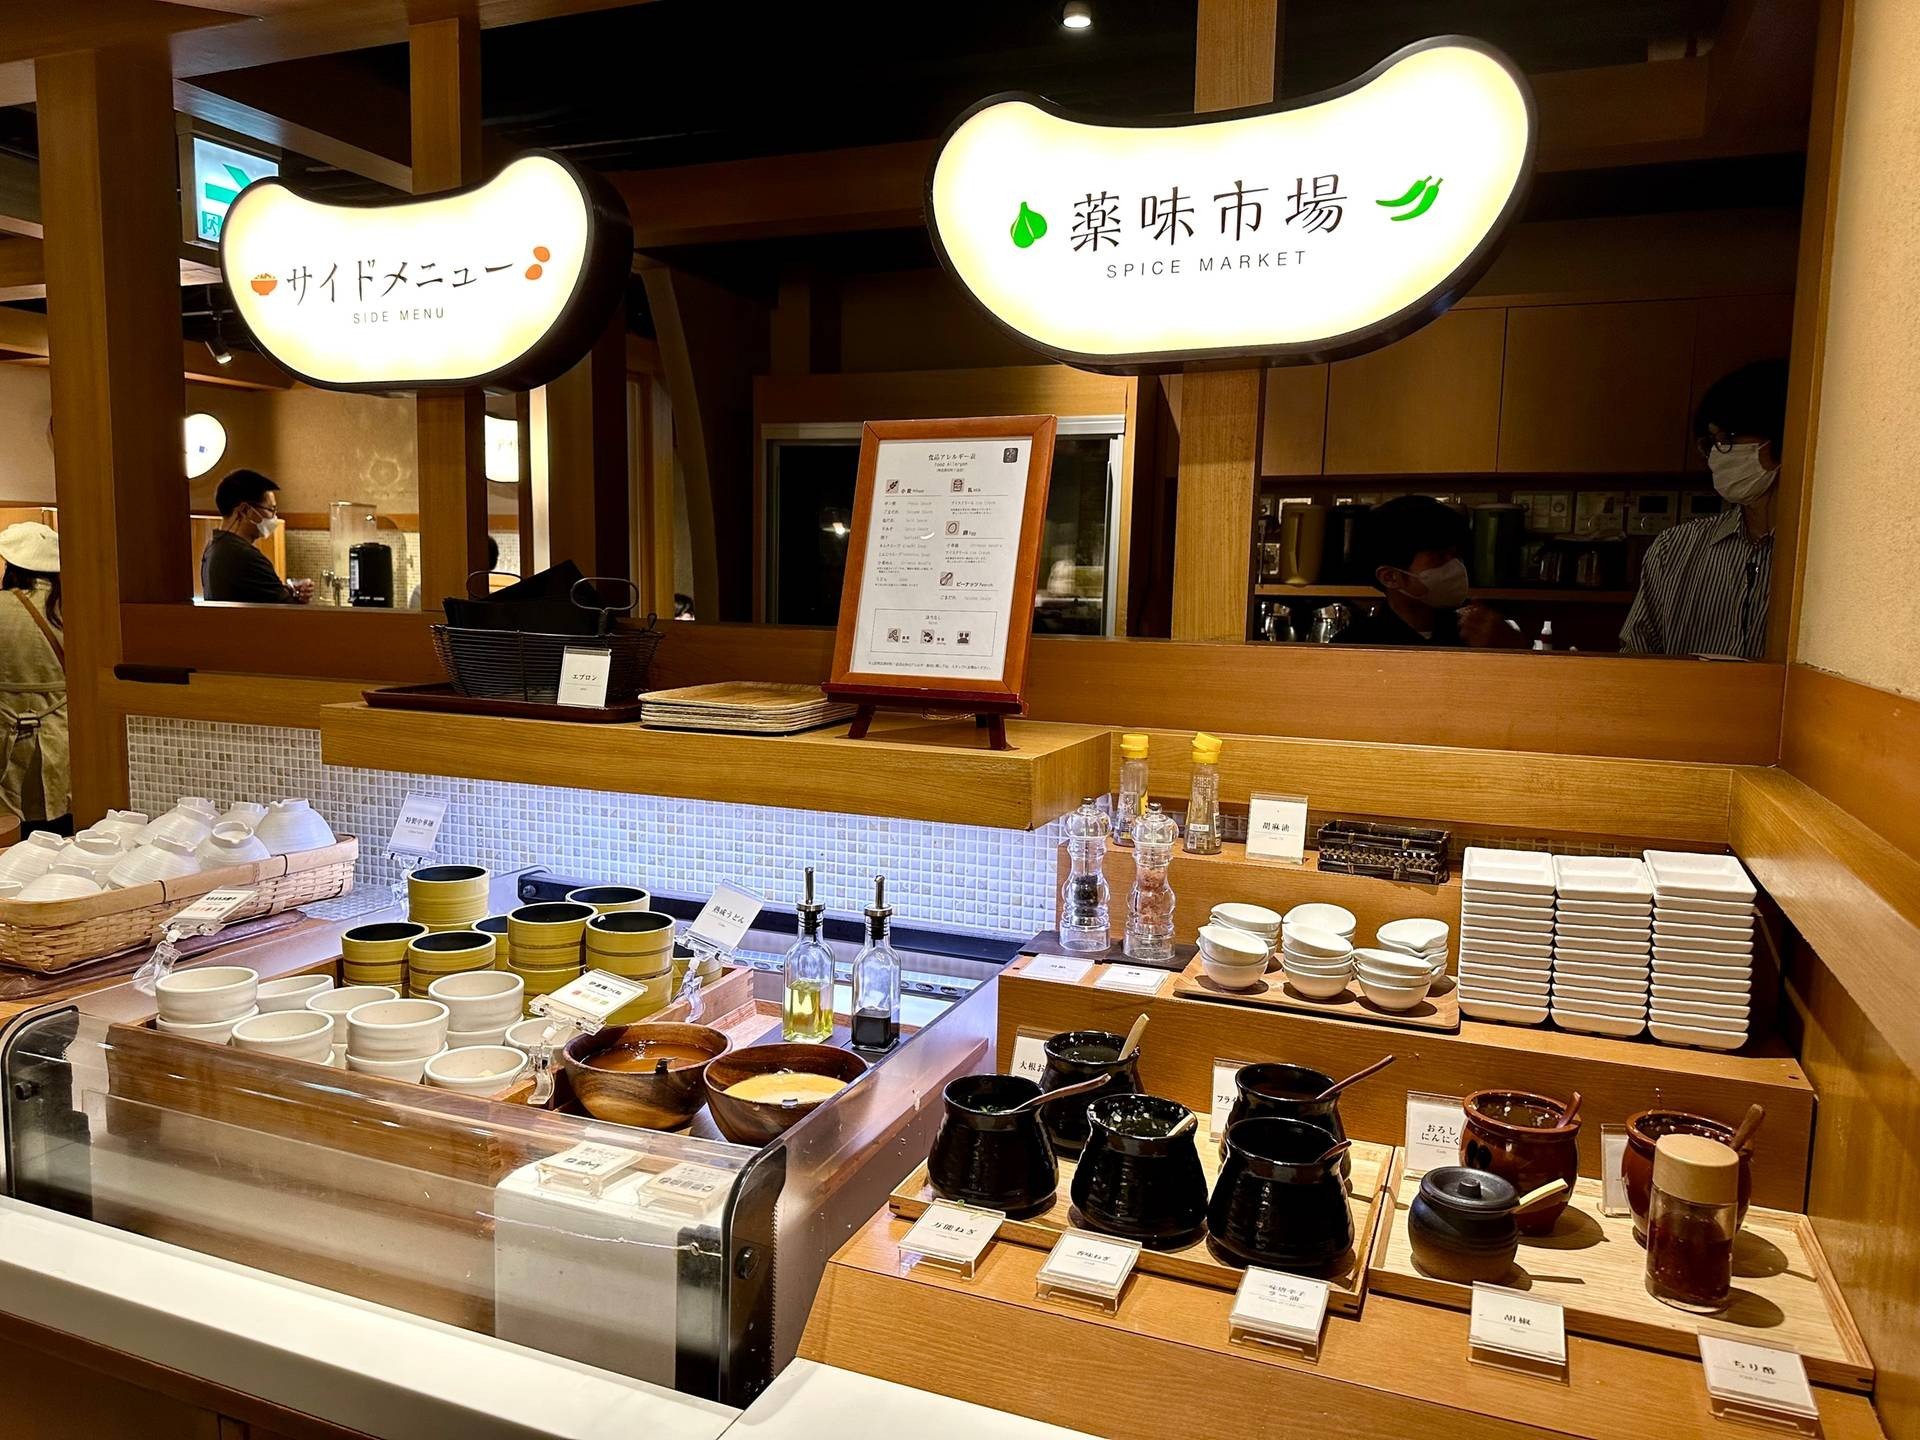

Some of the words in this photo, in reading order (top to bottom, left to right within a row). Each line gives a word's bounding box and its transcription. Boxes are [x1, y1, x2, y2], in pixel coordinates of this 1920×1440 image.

[1069, 174, 1349, 254] 薬味市場
[1106, 258, 1182, 280] SPICE
[1199, 249, 1309, 273] MARKET
[286, 258, 514, 306] サイドメニュー
[353, 309, 390, 325] SIDE
[399, 306, 446, 322] MENU
[1421, 1132, 1460, 1146] にんにく
[1427, 1124, 1456, 1136] おろし
